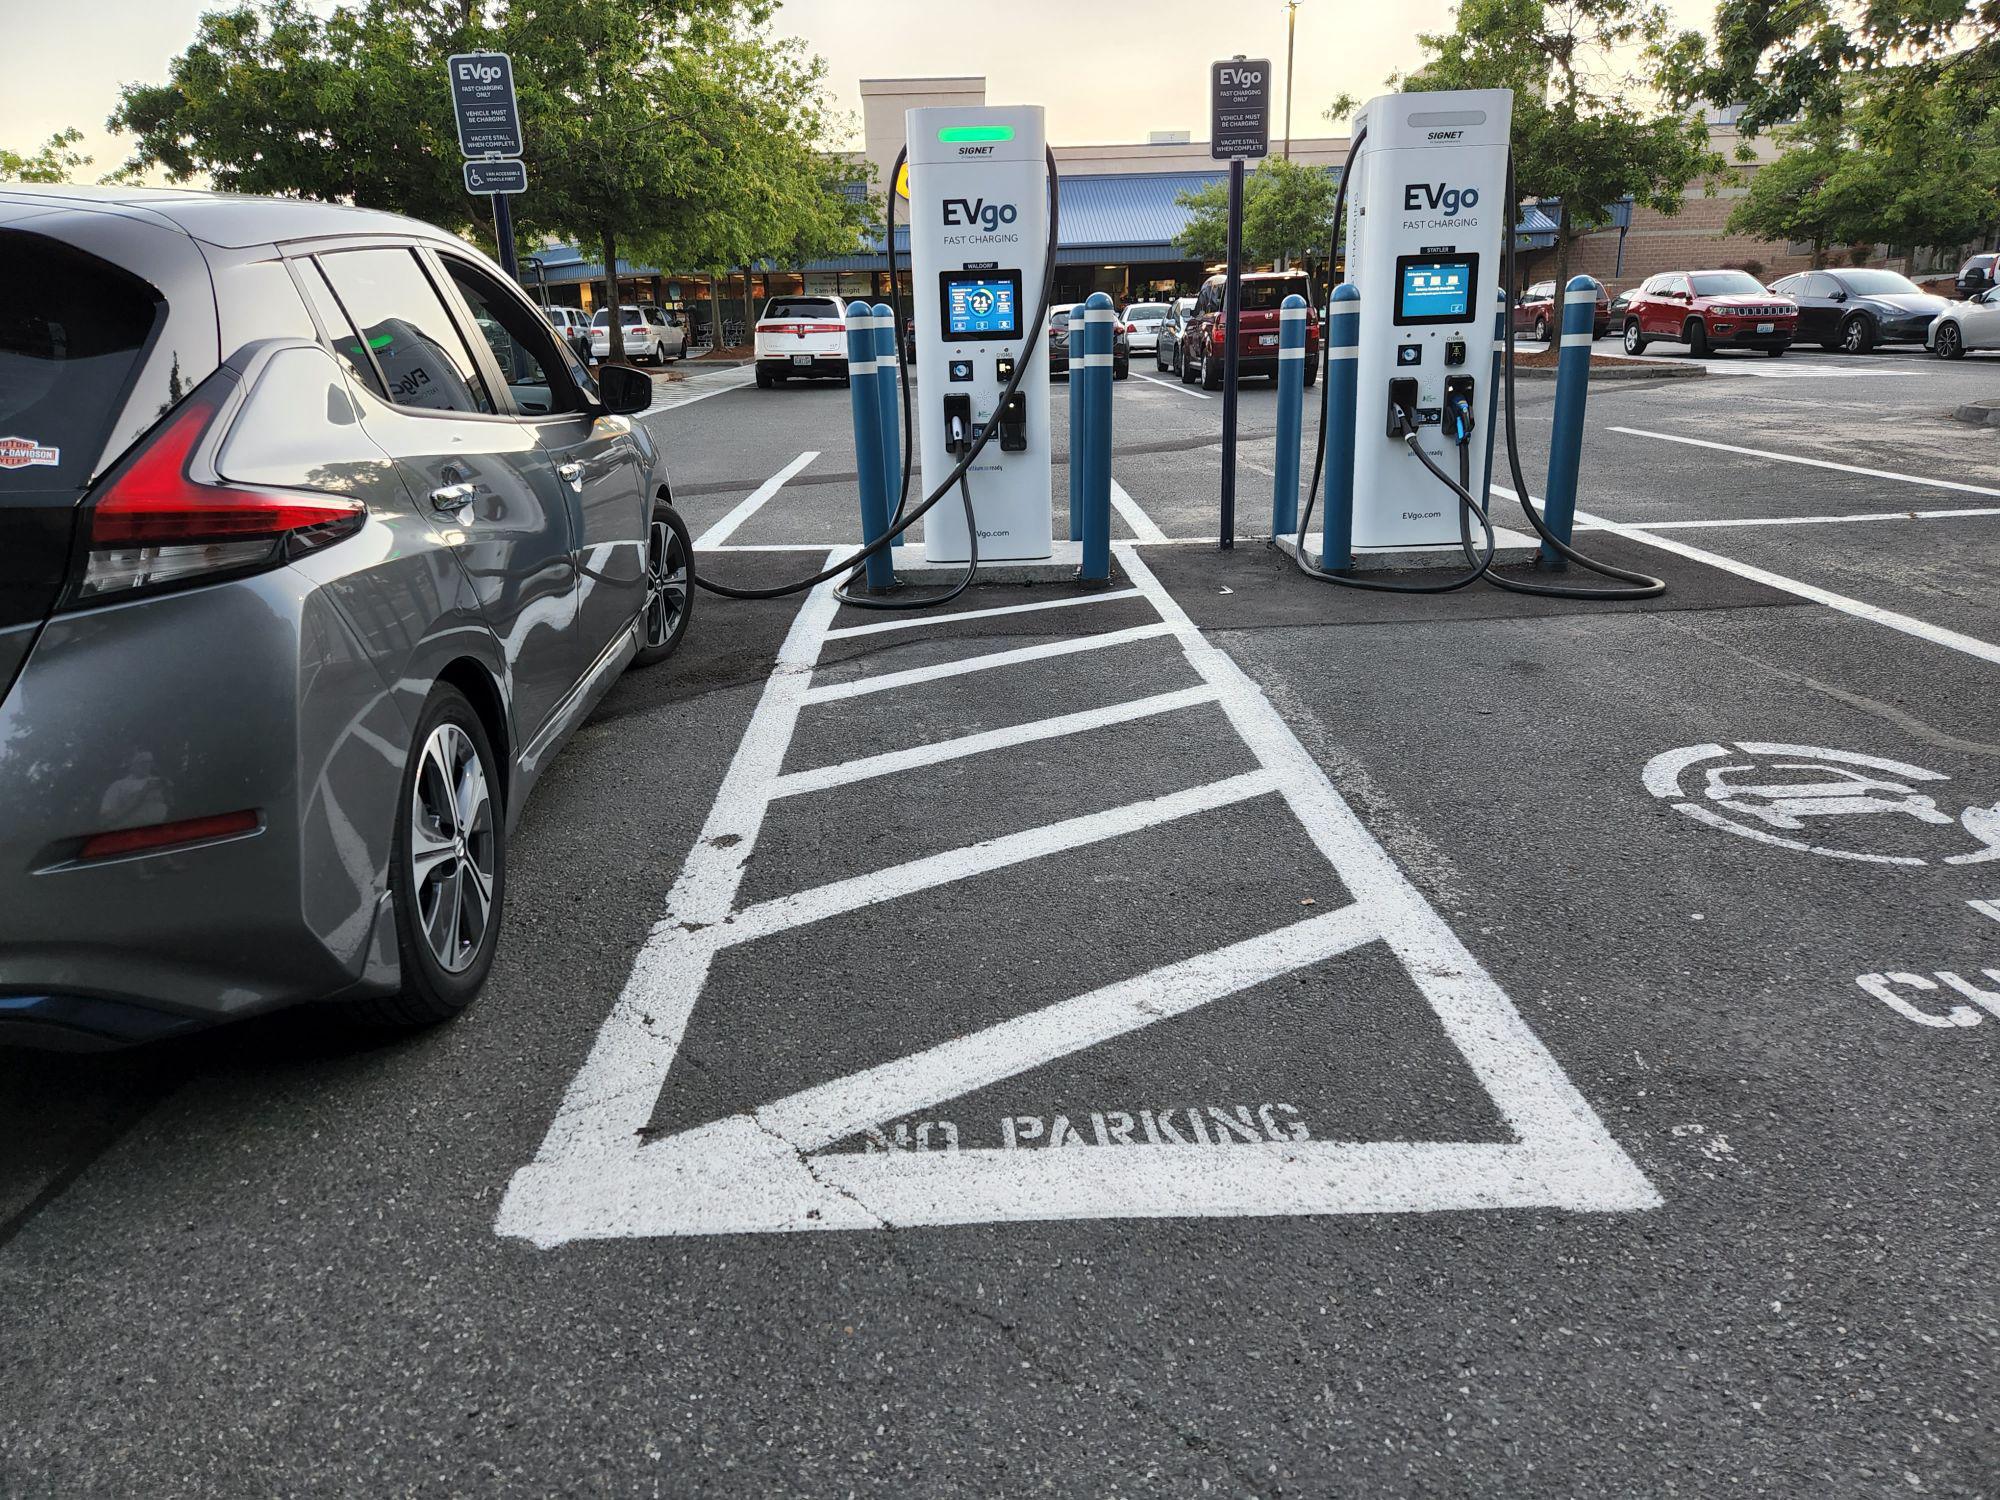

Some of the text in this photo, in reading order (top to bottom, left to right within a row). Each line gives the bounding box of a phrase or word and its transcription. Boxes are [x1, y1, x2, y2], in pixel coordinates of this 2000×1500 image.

[458, 63, 502, 83] EVgo
[1220, 68, 1262, 88] EVgo
[475, 84, 504, 92] CHARGING
[1427, 130, 1464, 140] SIGNET
[485, 140, 515, 148] COMPLETE
[958, 146, 995, 155] SIGNET
[1404, 182, 1479, 217] EVgo
[942, 198, 1018, 232] EVgo
[1403, 218, 1478, 230] FAST CHARGING
[943, 233, 1019, 245] FAST CHARGING
[1402, 511, 1441, 521] EVgo.com
[976, 530, 1010, 539] Vgo.com
[1001, 1103, 1310, 1149] PARKING
